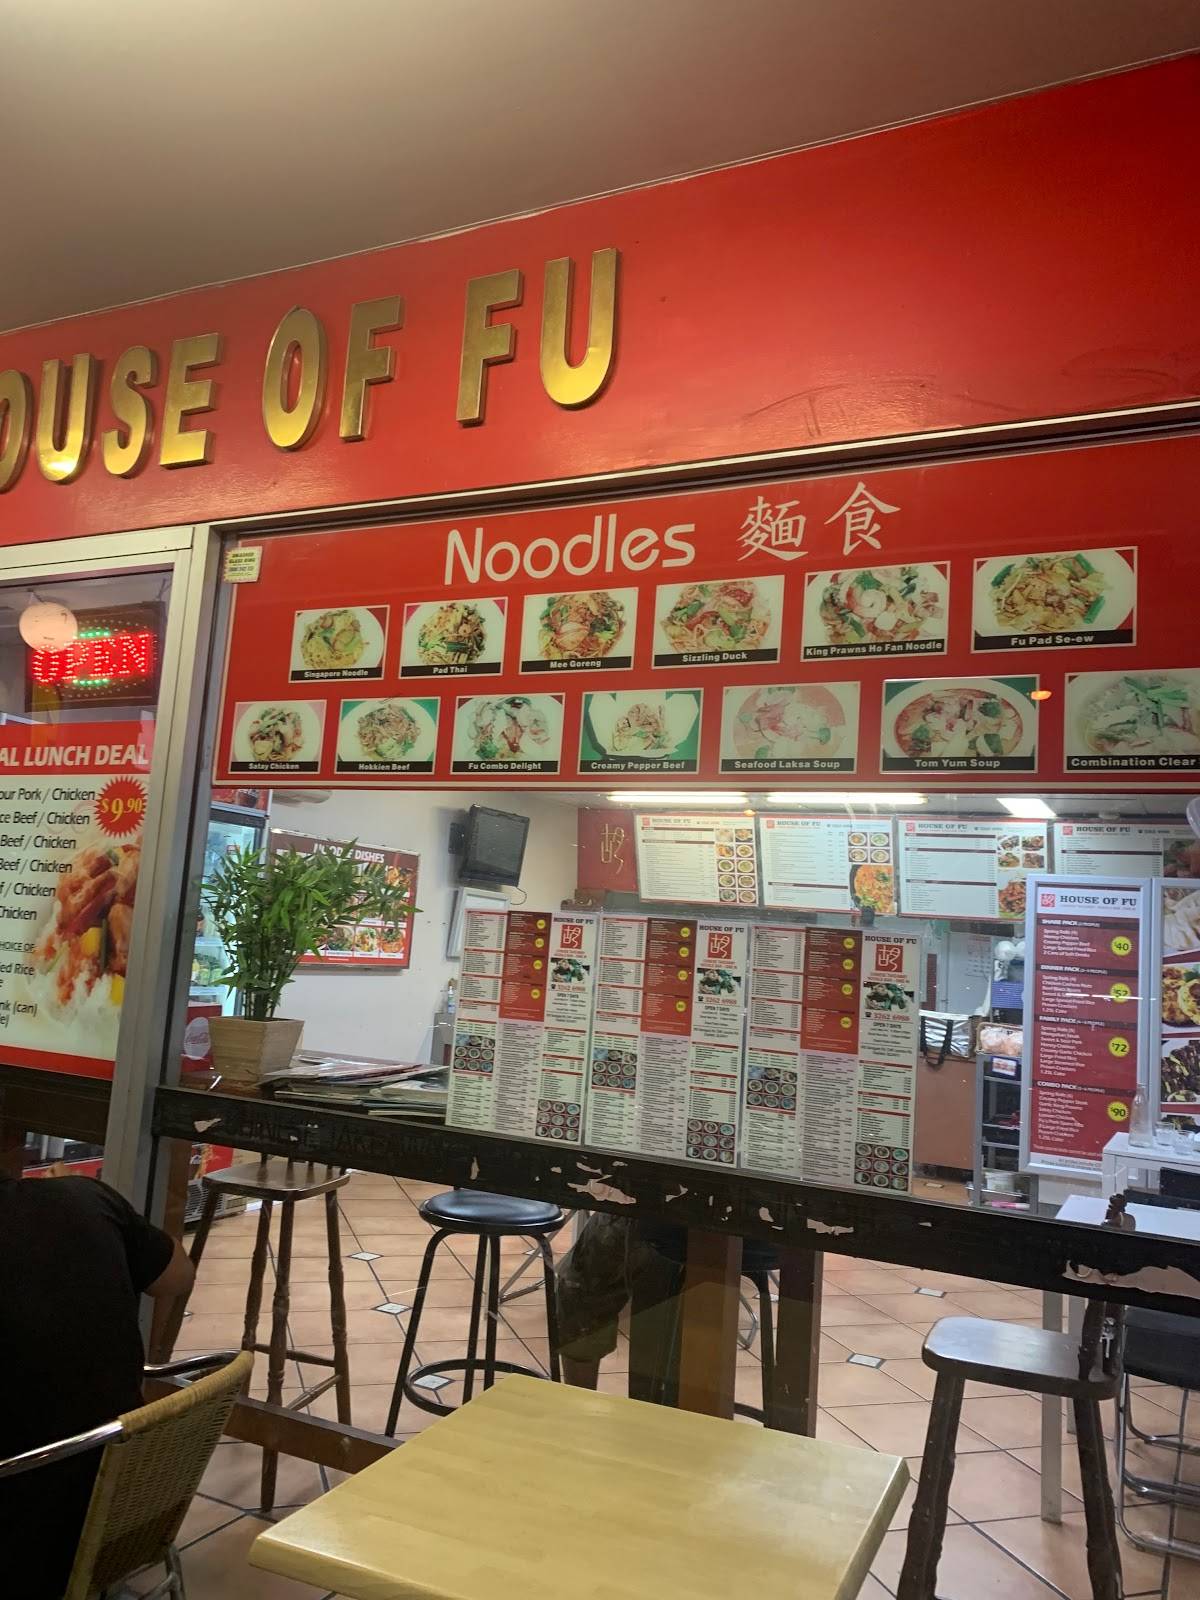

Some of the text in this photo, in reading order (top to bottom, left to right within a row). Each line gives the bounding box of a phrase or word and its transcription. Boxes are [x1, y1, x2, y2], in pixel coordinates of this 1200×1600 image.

[262, 295, 404, 450] OF
[456, 247, 621, 426] FU
[444, 513, 696, 585] Noodles
[1010, 634, 1094, 646] Fu Pad Se-ew
[806, 641, 943, 657] King Prawns Ho Fan Noodle
[33, 634, 150, 683] OPEN
[682, 651, 748, 663] Sizzling Duck
[432, 665, 468, 674] Pad Thai
[549, 659, 602, 669] Mee Goreng
[304, 669, 369, 679] Singapore Noodle
[23, 745, 91, 767] LUNCH
[94, 744, 149, 766] DEAL
[270, 762, 300, 770] Chicken
[358, 763, 410, 771] Hokkien Beef
[468, 761, 542, 771] Fu Combo Delight
[591, 761, 685, 771] Creamy Pepper Beef
[734, 759, 841, 770] Seafood Laksa Soup
[914, 758, 1001, 769] Tom Yum Soup
[1071, 757, 1196, 767] Combination Clear
[18, 788, 42, 800] Pork
[52, 788, 96, 801] Chicken
[13, 811, 38, 824] Beef
[46, 811, 90, 825] Chicken
[0, 834, 25, 847] Beef
[33, 834, 77, 849] Chicken
[29, 859, 73, 874] Chicken
[13, 882, 56, 897] Chicken
[1059, 895, 1137, 906] HOUSE OF FU
[864, 935, 892, 943] HOUSE
[14, 963, 35, 976] Rice
[13, 1001, 38, 1018] (can)
